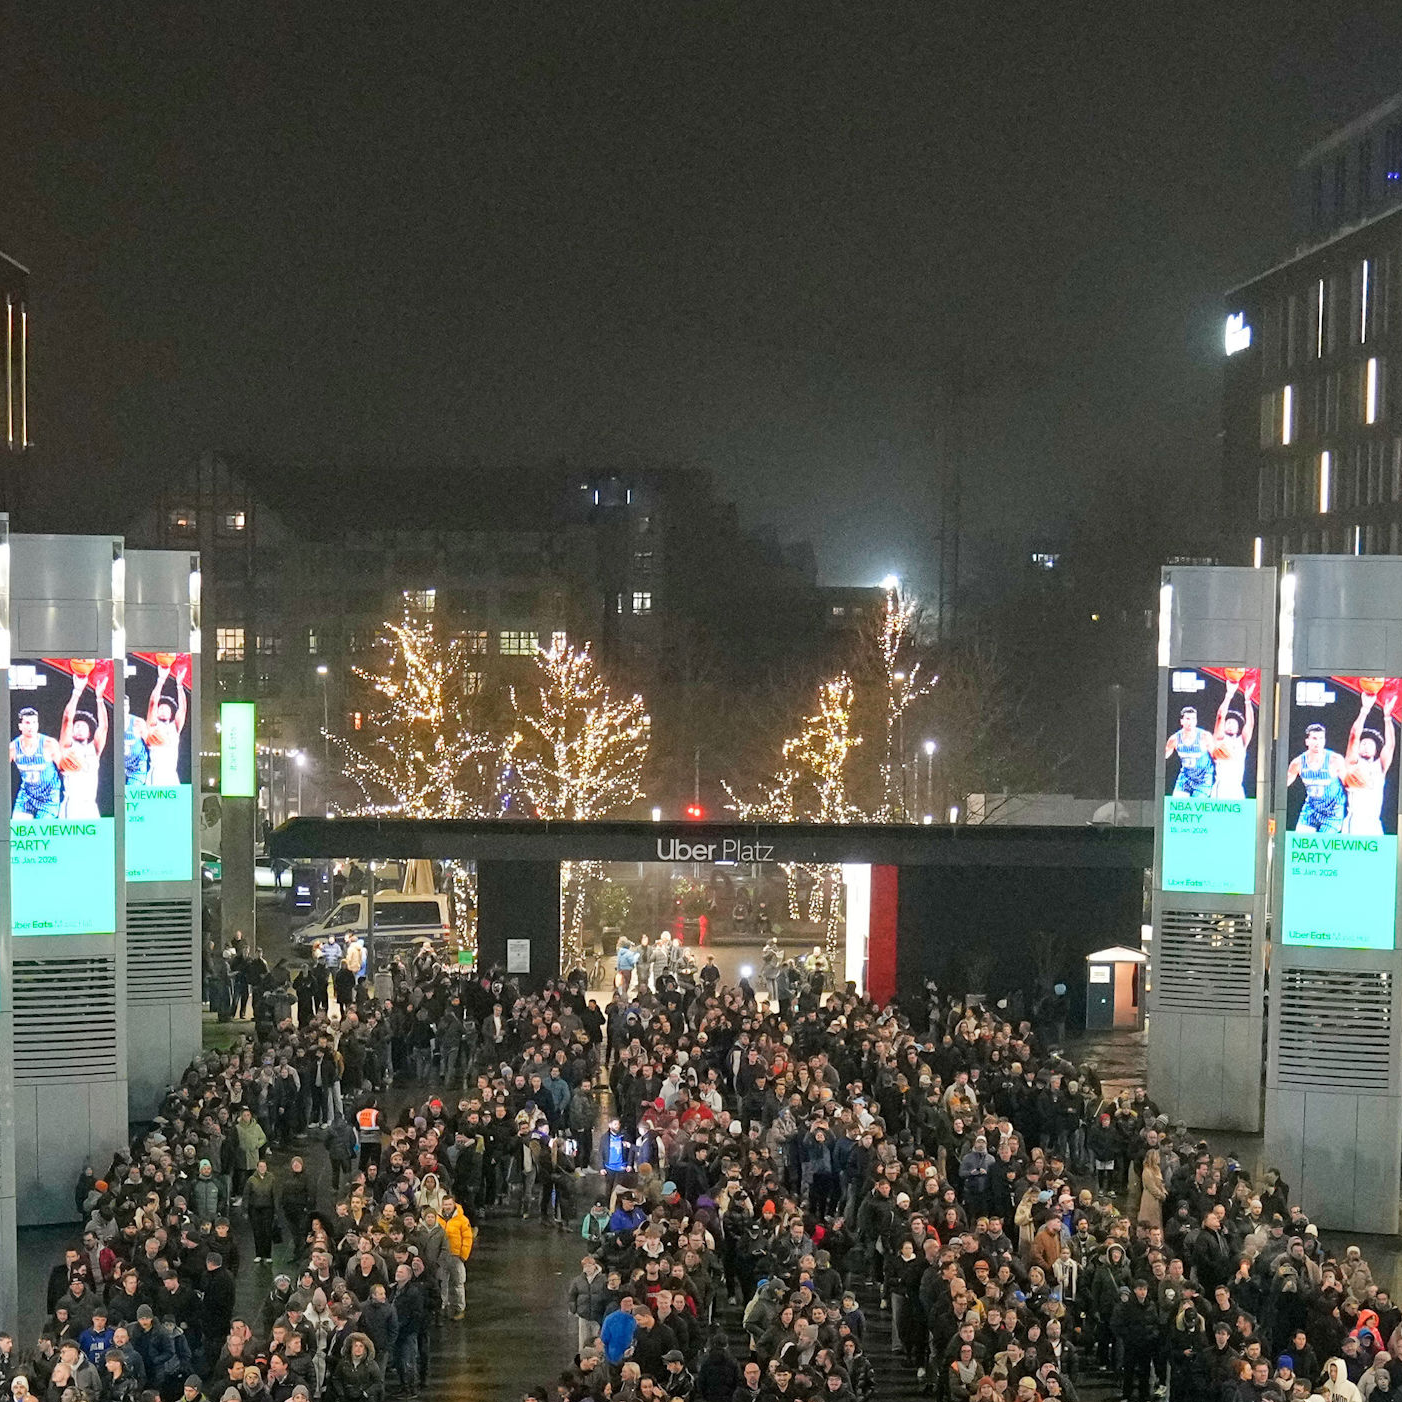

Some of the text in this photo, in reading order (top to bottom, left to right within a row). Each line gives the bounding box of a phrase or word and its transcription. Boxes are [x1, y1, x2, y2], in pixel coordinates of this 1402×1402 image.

[129, 790, 177, 800] VIEWING
[1169, 801, 1241, 813] NBA VIEWING
[1169, 813, 1203, 823] PARTY
[39, 824, 97, 836] VIEWING
[9, 839, 51, 851] PARTY
[657, 838, 774, 861] Uber Platz
[1291, 838, 1378, 852] NBA VIEWING
[38, 856, 58, 864] 2026
[1291, 851, 1332, 864] PARTY
[1185, 879, 1203, 887] Eats
[32, 920, 53, 929] Eats
[1310, 931, 1331, 940] Eats
